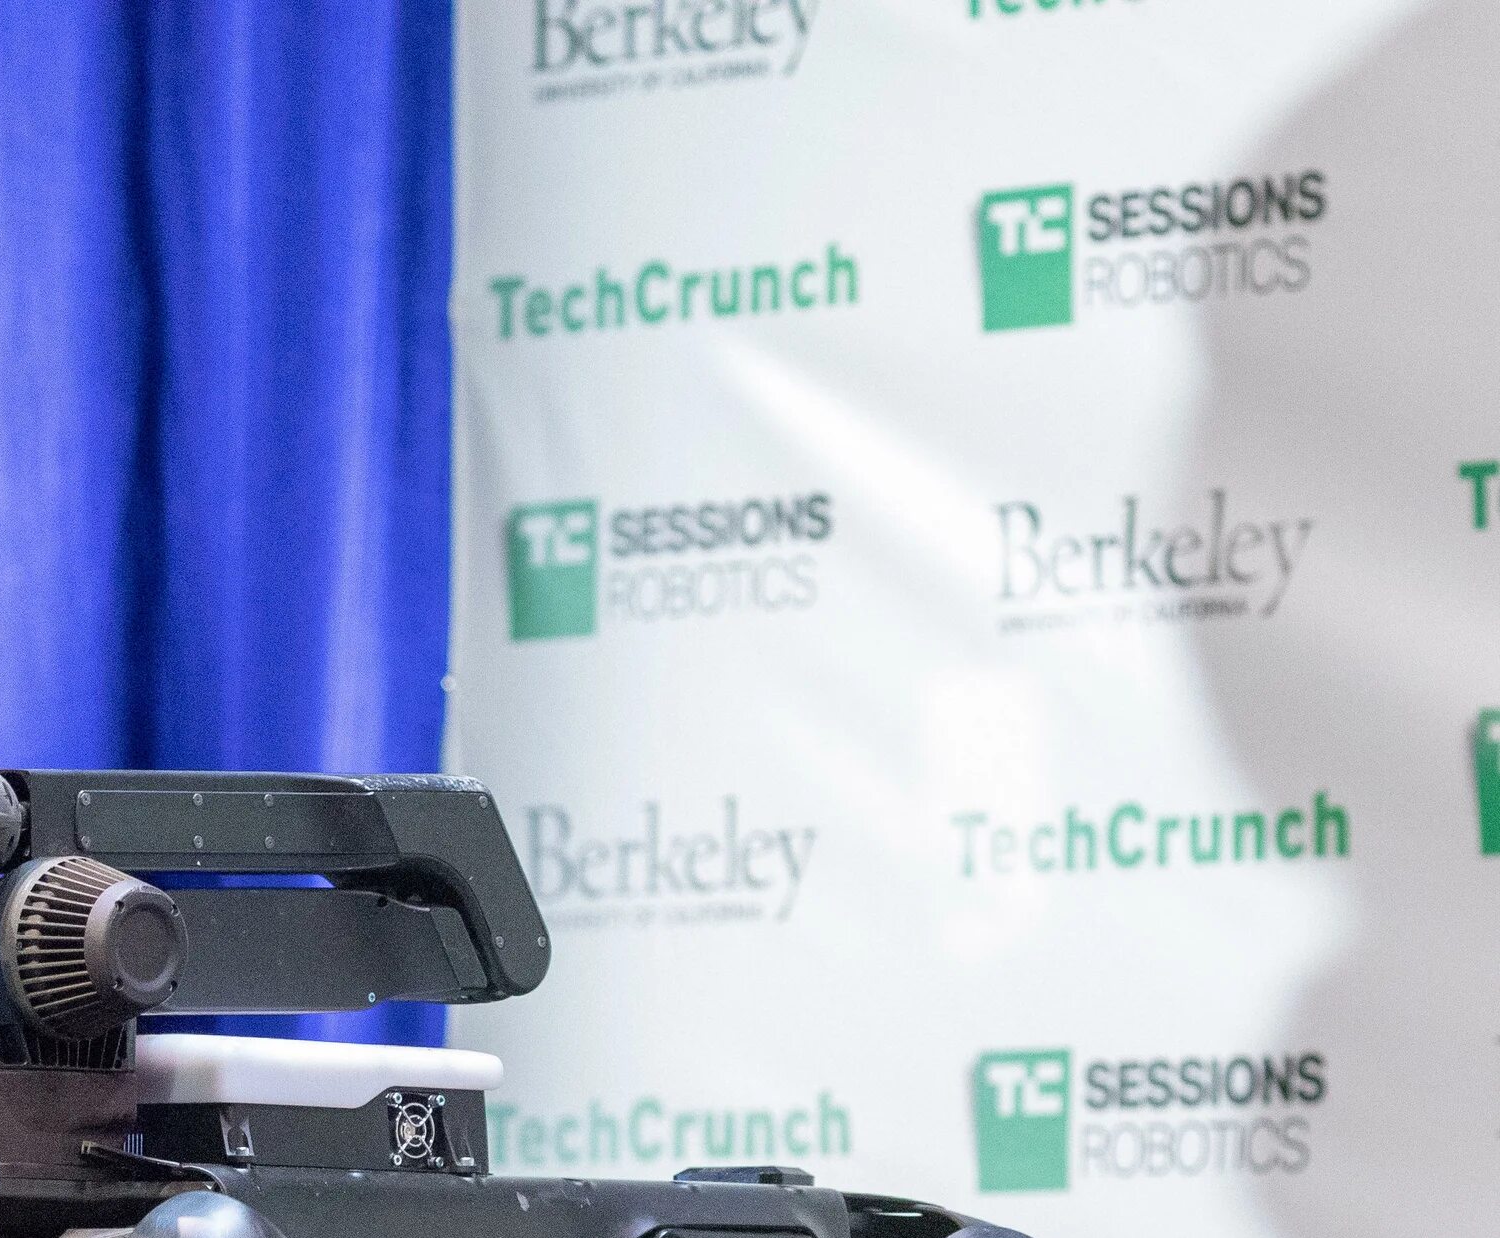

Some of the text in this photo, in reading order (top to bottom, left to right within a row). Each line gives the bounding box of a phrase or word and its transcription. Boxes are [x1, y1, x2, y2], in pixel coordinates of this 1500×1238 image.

[1087, 168, 1328, 242] SESSIONS
[489, 242, 860, 340] TechCrunch
[1085, 236, 1312, 307] ROBOTICS
[610, 491, 834, 559] SESSIONS
[993, 487, 1315, 619] Berkeley
[608, 555, 818, 622] ROBOTICS
[524, 793, 817, 923] Berkeley
[950, 789, 1351, 877] TechCrunch
[1084, 1051, 1329, 1111] SESSIONS
[487, 1091, 853, 1168] TechCrunch
[1082, 1117, 1312, 1177] ROBOTICS
